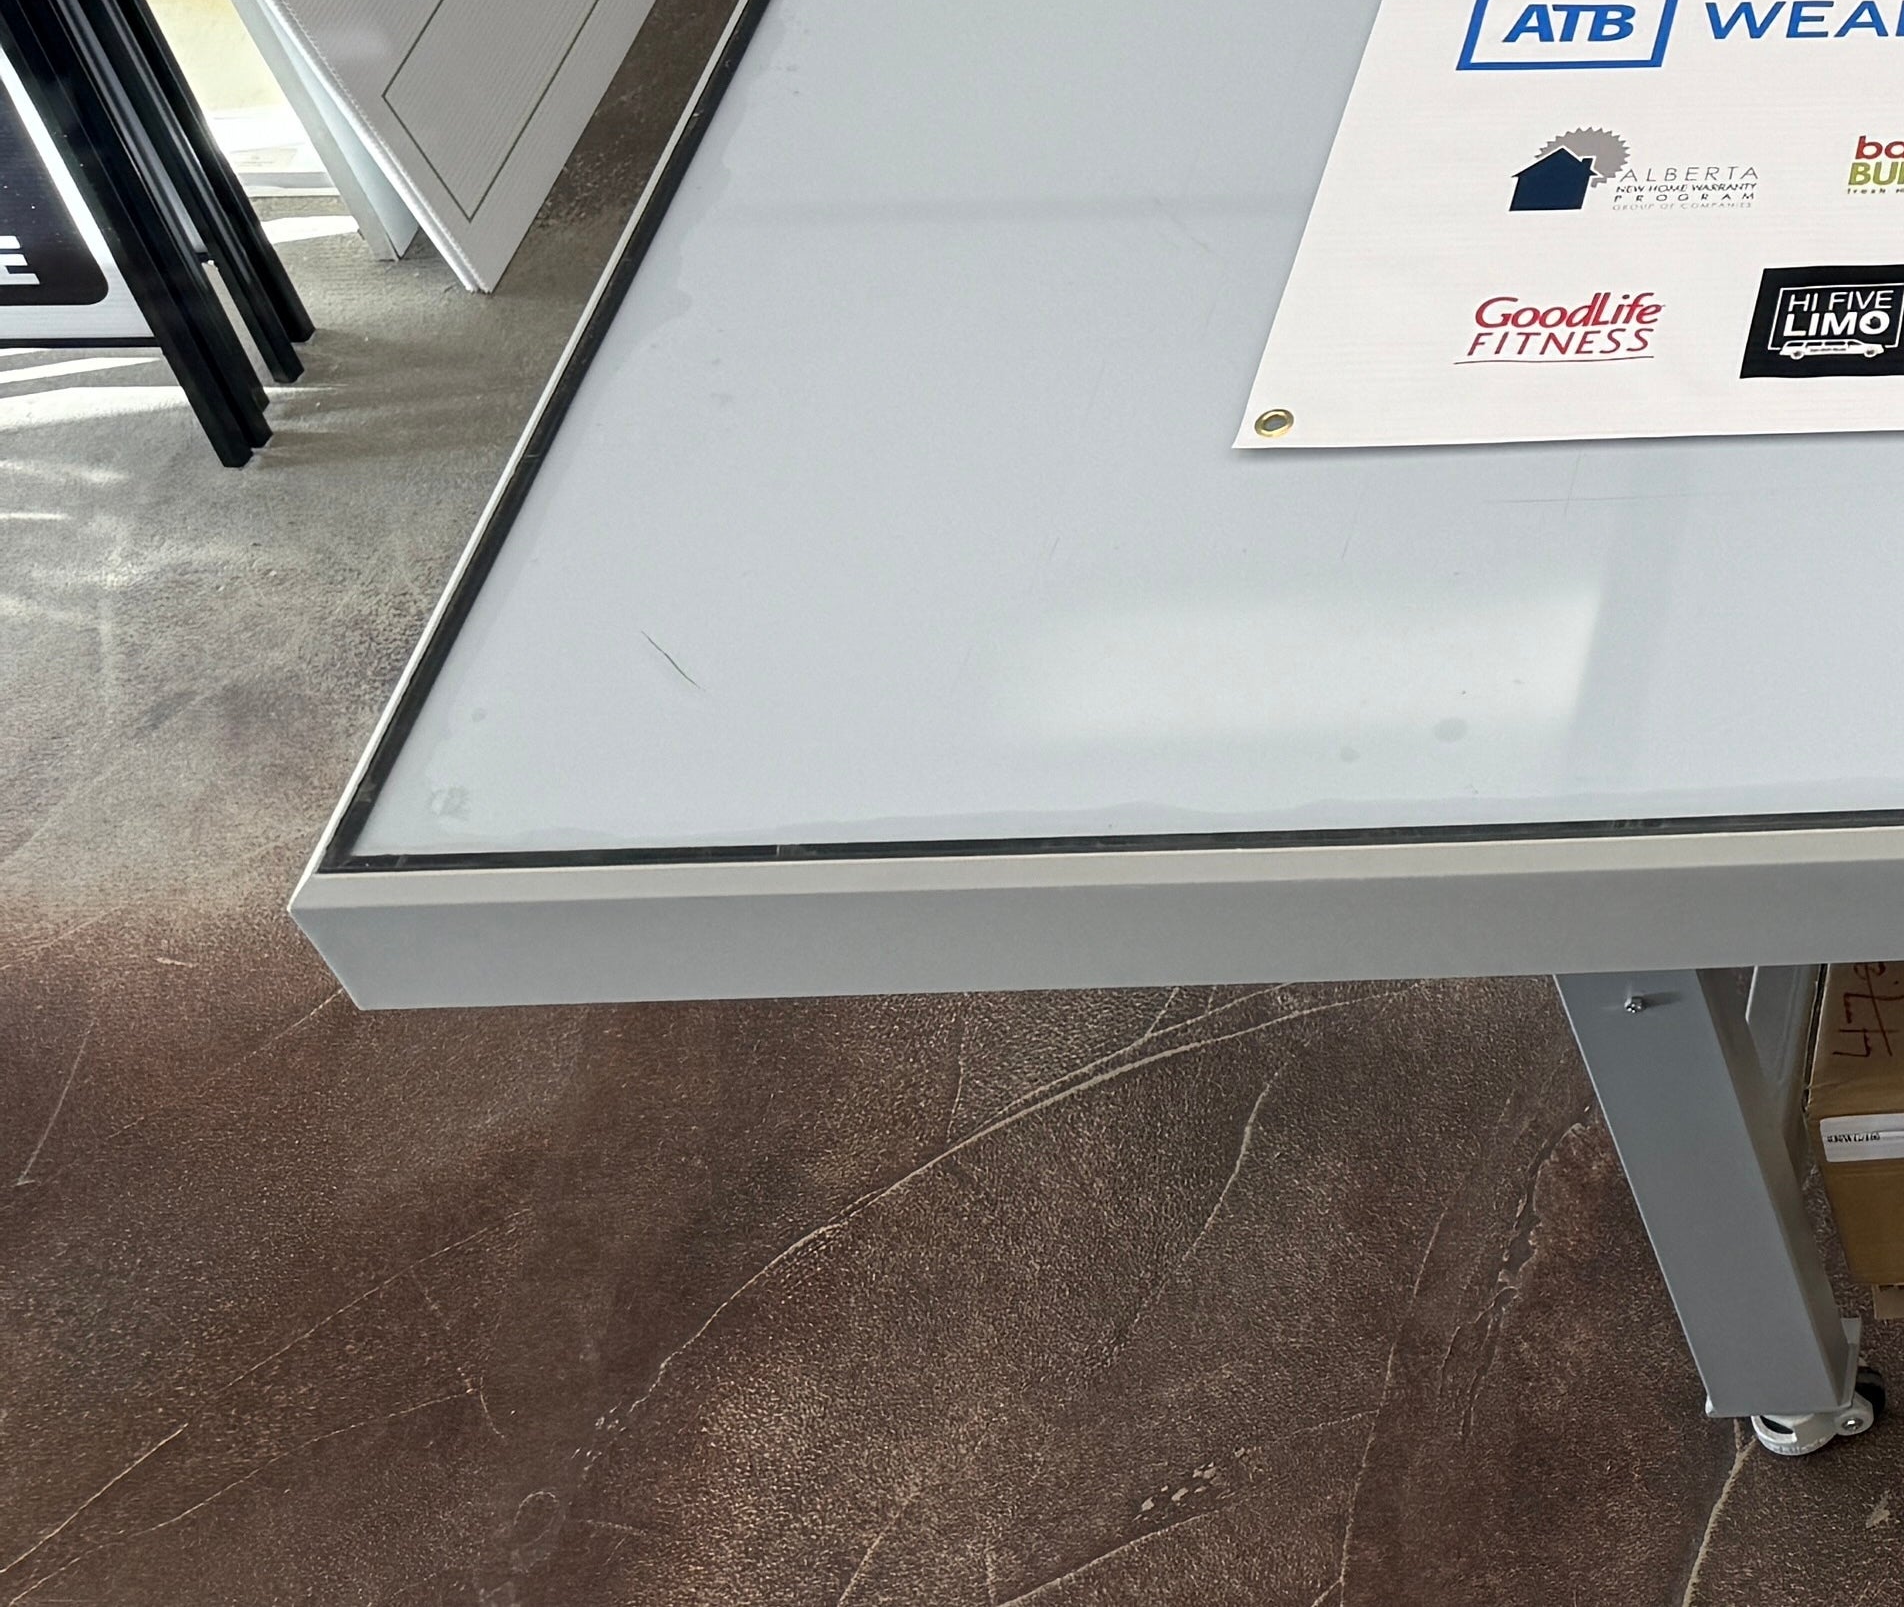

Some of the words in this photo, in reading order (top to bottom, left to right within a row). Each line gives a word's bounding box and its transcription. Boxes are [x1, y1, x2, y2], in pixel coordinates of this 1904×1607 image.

[1502, 3, 1636, 43] ATB
[1620, 166, 1758, 183] ALBERTA
[1474, 291, 1664, 329] GoodLife
[1788, 293, 1819, 311] HI
[1828, 290, 1894, 311] FIVE
[1783, 310, 1890, 337] LIMO
[1467, 328, 1655, 357] FITNESS
